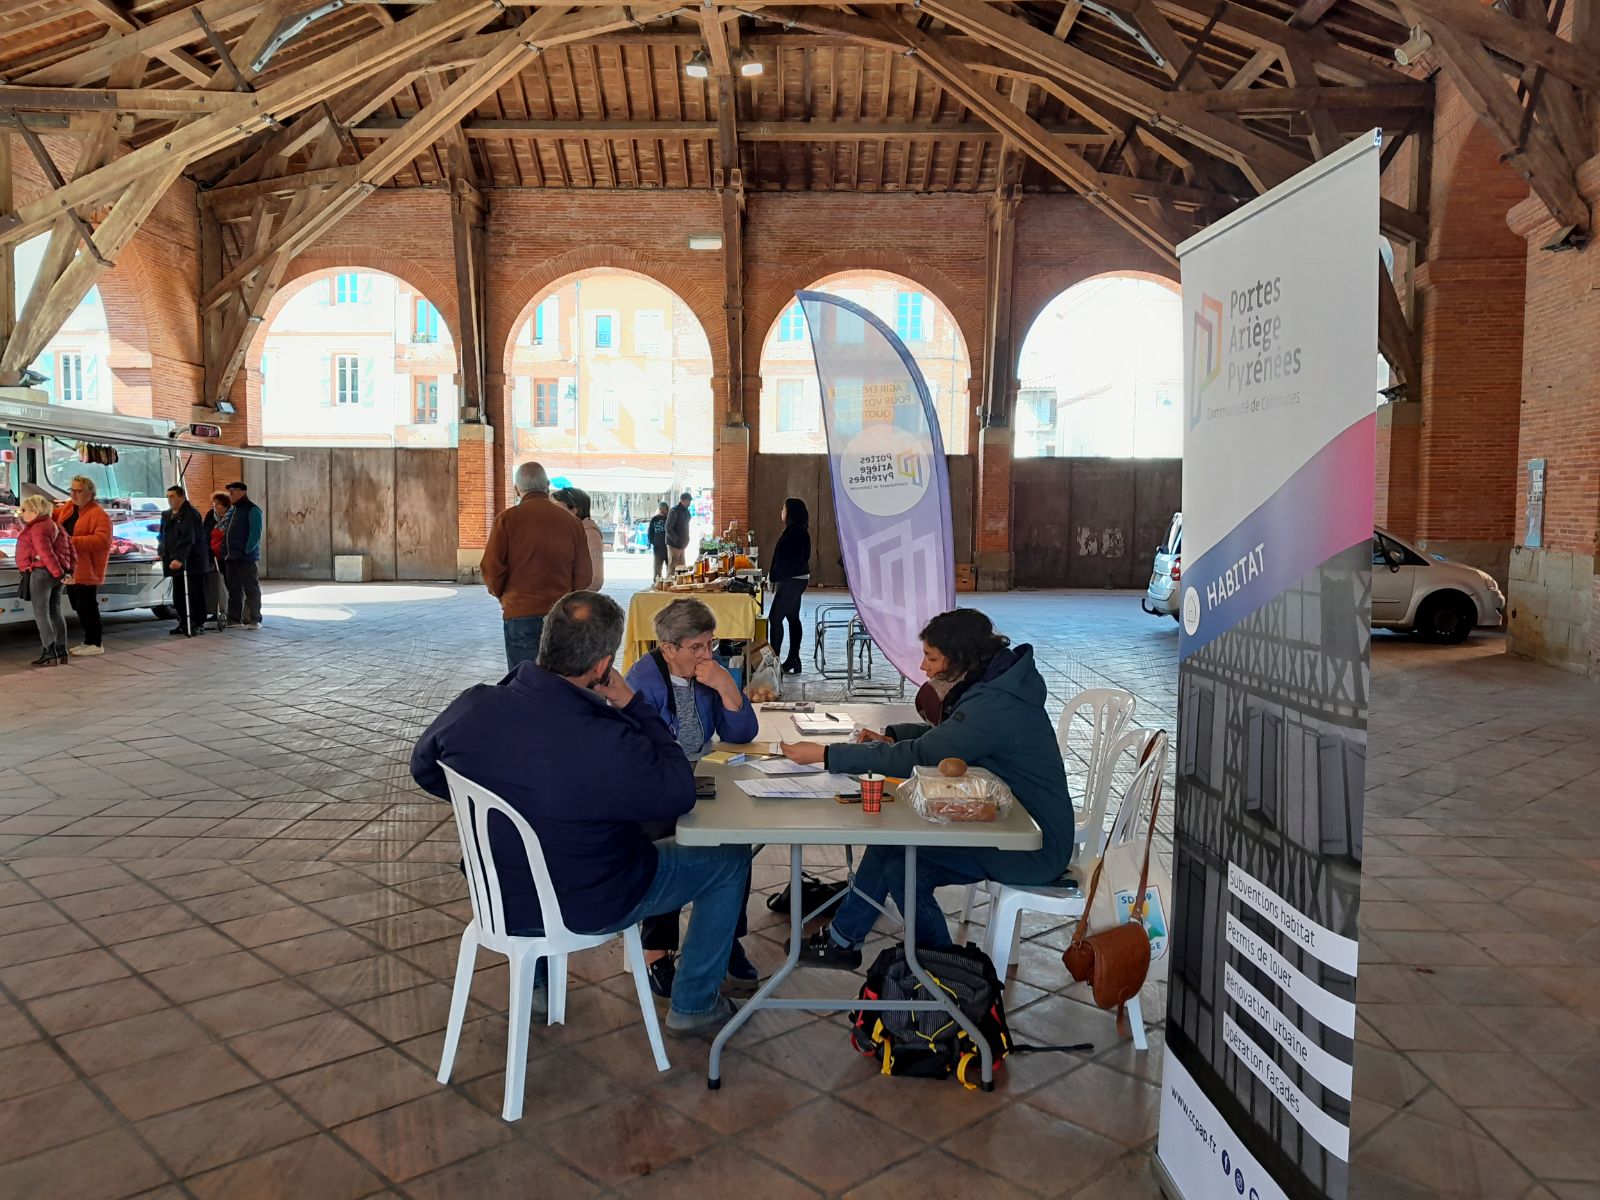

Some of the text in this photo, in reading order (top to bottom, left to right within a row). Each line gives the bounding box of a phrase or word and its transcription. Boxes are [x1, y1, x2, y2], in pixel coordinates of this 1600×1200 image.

[1230, 276, 1281, 319] Portes
[1229, 315, 1281, 355] Ariège
[1228, 345, 1302, 395] Pyrénées
[1251, 397, 1260, 413] de
[1206, 542, 1265, 611] HABITAT
[1229, 870, 1316, 948] Subventions habitat
[1227, 920, 1293, 988] Permis de louer
[1226, 970, 1308, 1062] Rénovation urbaine
[1224, 1021, 1301, 1113] Opération façades
[1170, 1085, 1217, 1154] www.ccpap.fr
